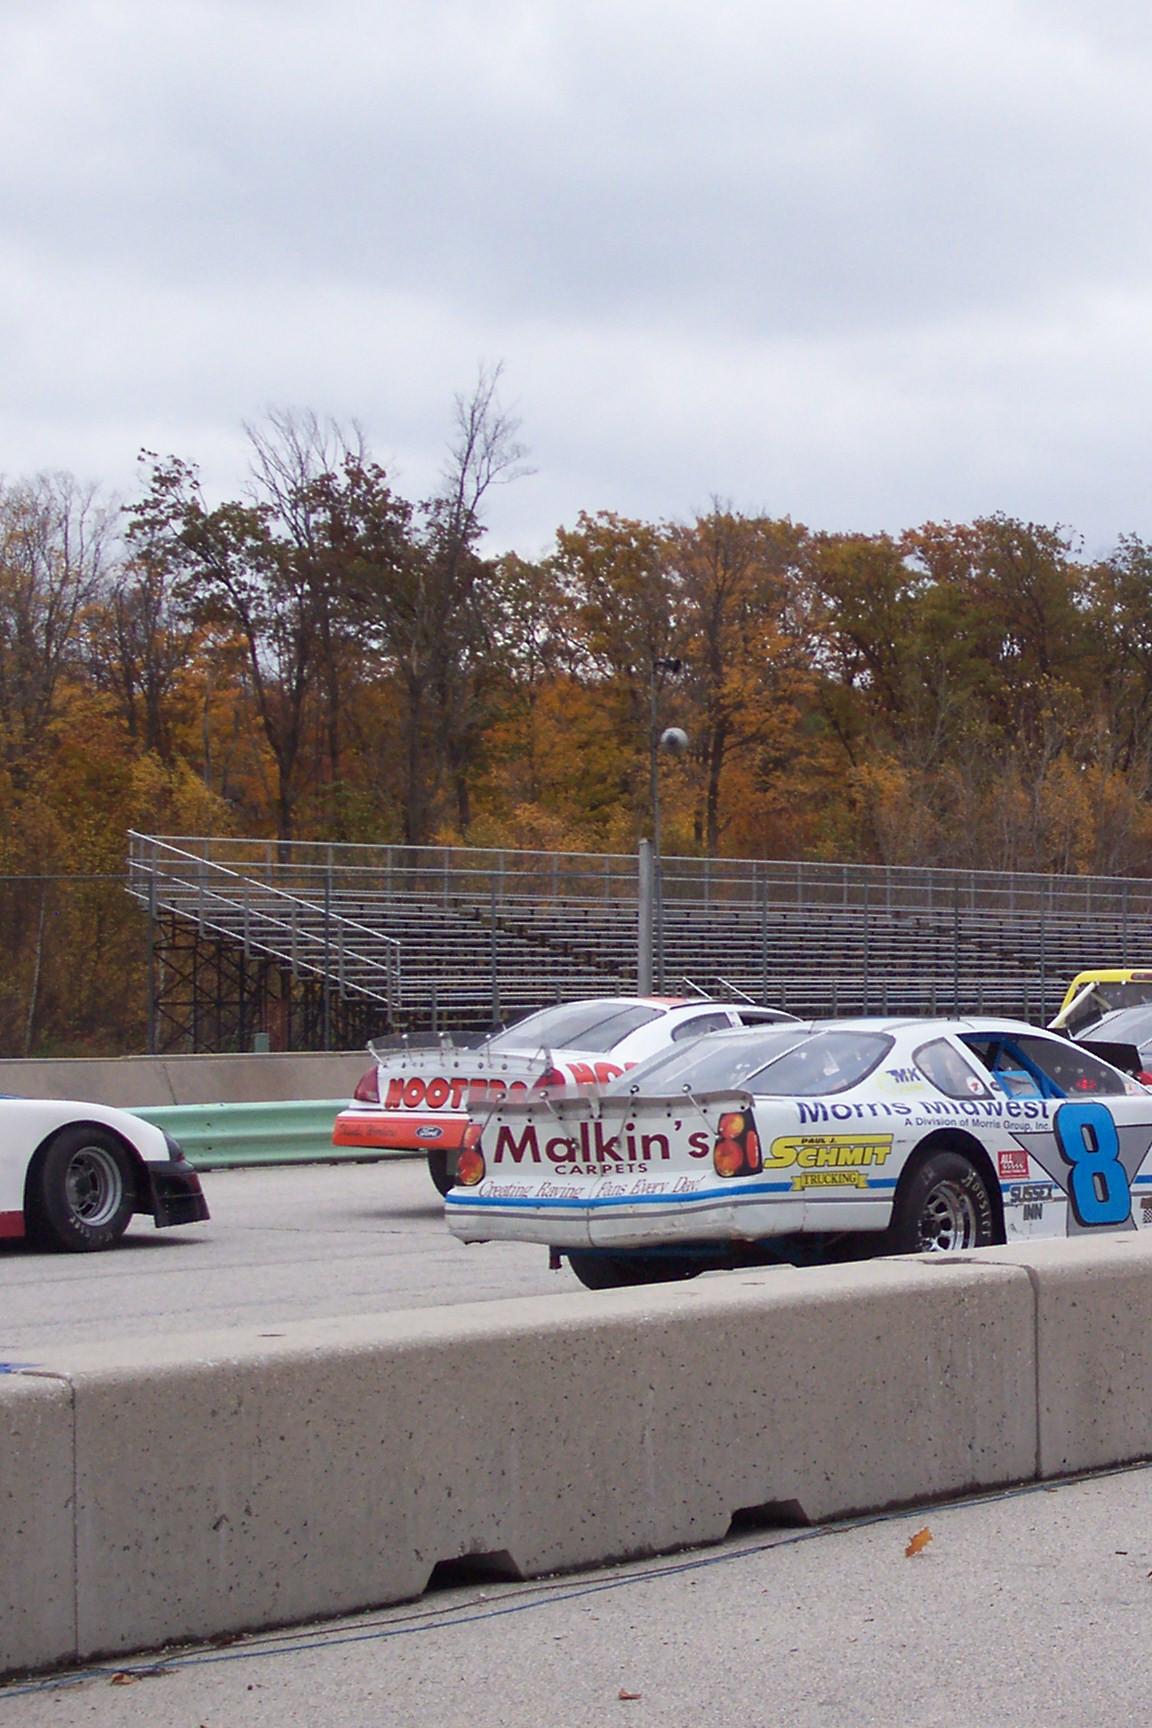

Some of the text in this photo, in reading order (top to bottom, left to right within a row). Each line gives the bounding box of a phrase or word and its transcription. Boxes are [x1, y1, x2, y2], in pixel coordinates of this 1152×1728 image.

[797, 1099, 1050, 1124] Morris Midwest
[904, 1117, 914, 1127] A
[915, 1117, 957, 1127] Division
[958, 1117, 970, 1127] of
[972, 1118, 1001, 1128] Morris
[494, 1120, 710, 1163] Malkin's
[764, 1133, 893, 1169] SCHMIT
[554, 1163, 649, 1175] CARPETS
[1053, 1101, 1132, 1227] 8
[802, 1172, 858, 1187] TRUCKING
[1009, 1184, 1054, 1204] SUSSEX
[1023, 1203, 1043, 1221] INN
